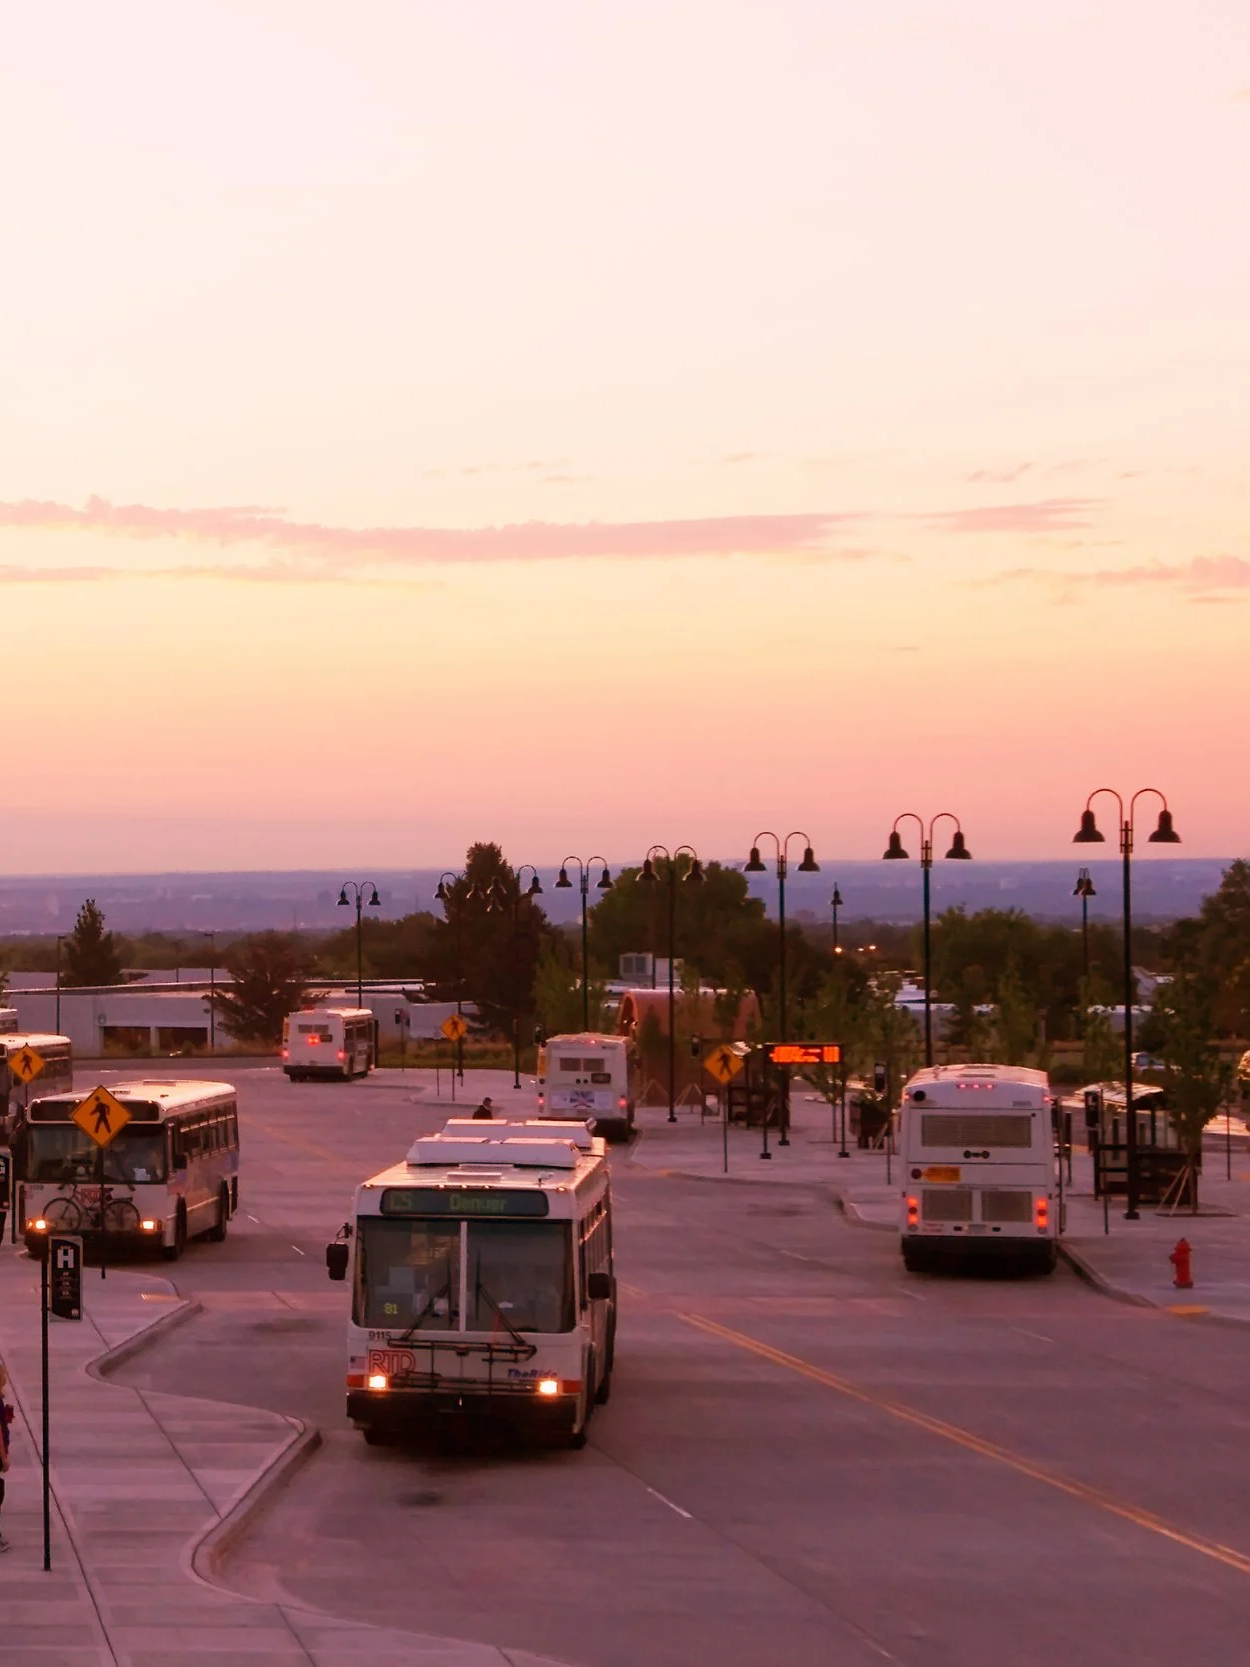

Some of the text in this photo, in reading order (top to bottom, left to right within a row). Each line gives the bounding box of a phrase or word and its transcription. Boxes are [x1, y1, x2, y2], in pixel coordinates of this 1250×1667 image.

[57, 1248, 74, 1269] H
[369, 1331, 391, 1340] 9115
[368, 1349, 416, 1376] RTD
